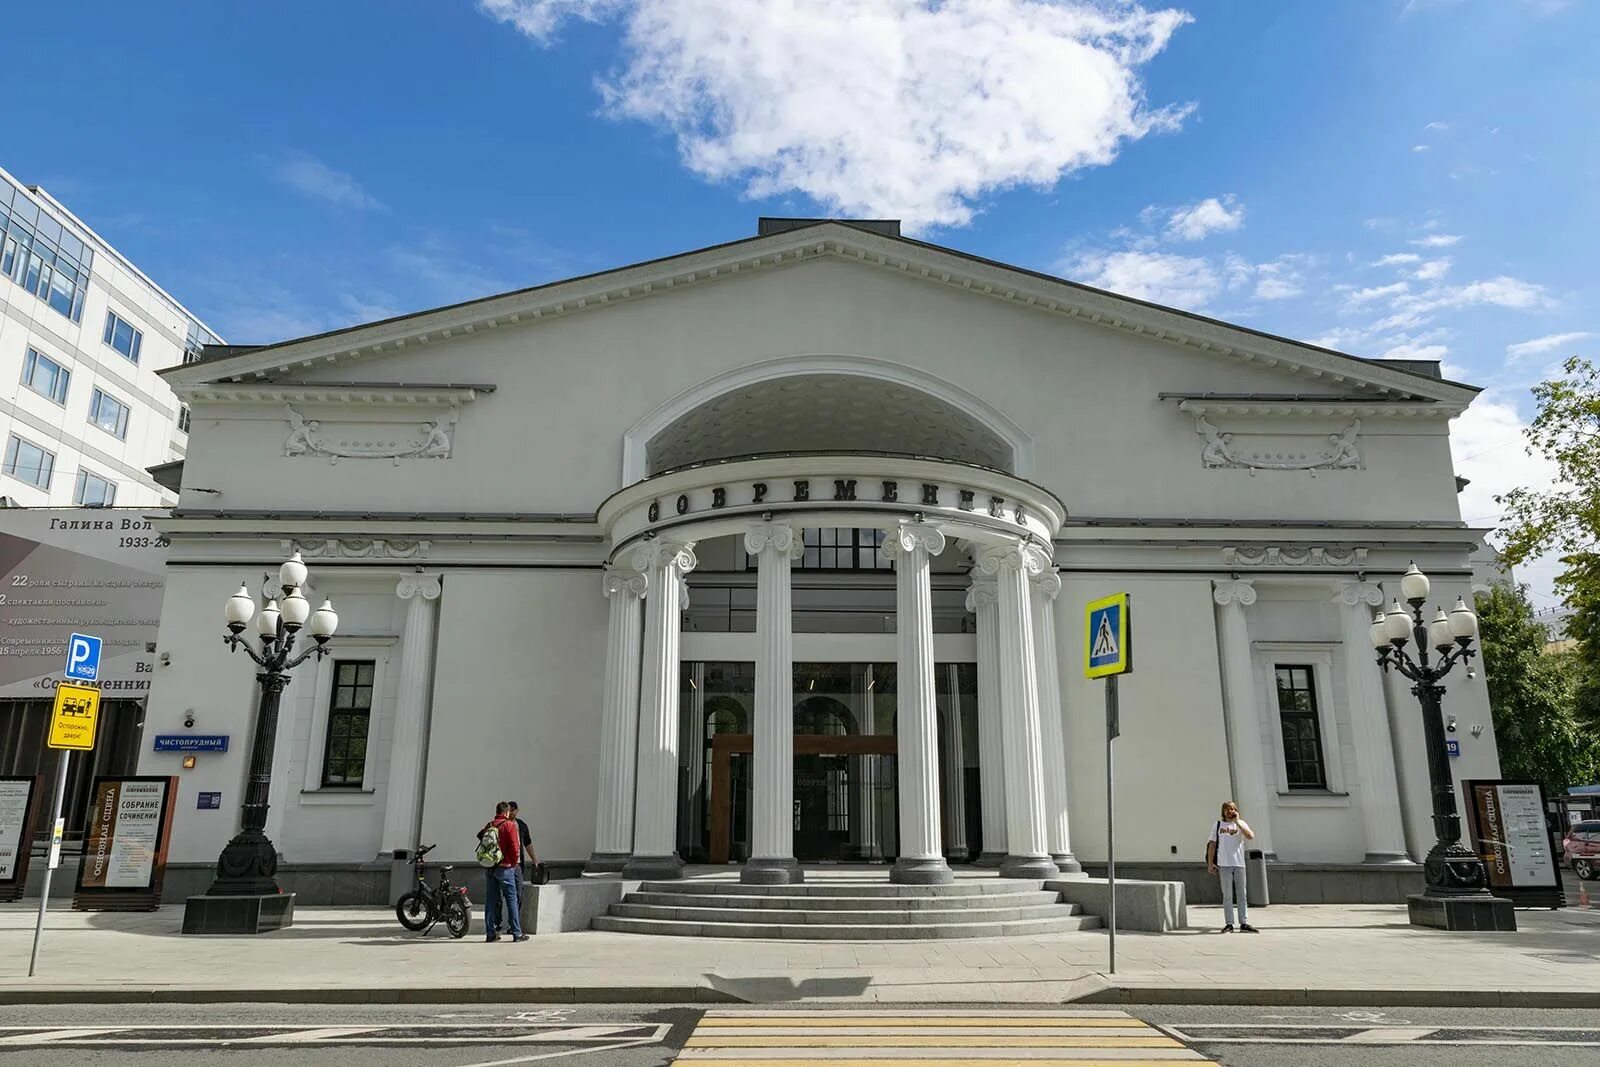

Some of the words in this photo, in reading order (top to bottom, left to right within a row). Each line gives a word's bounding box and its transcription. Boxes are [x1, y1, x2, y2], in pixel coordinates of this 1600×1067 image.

[49, 518, 114, 531] Галина
[12, 575, 28, 586] 22
[159, 738, 222, 747] ЧИСТОПРУДНЫЙ
[121, 801, 159, 809] СОБРАНИЕ
[119, 811, 158, 820] СОЧИНЕНИЙ
[93, 822, 110, 877] ОСНОВНАЯ
